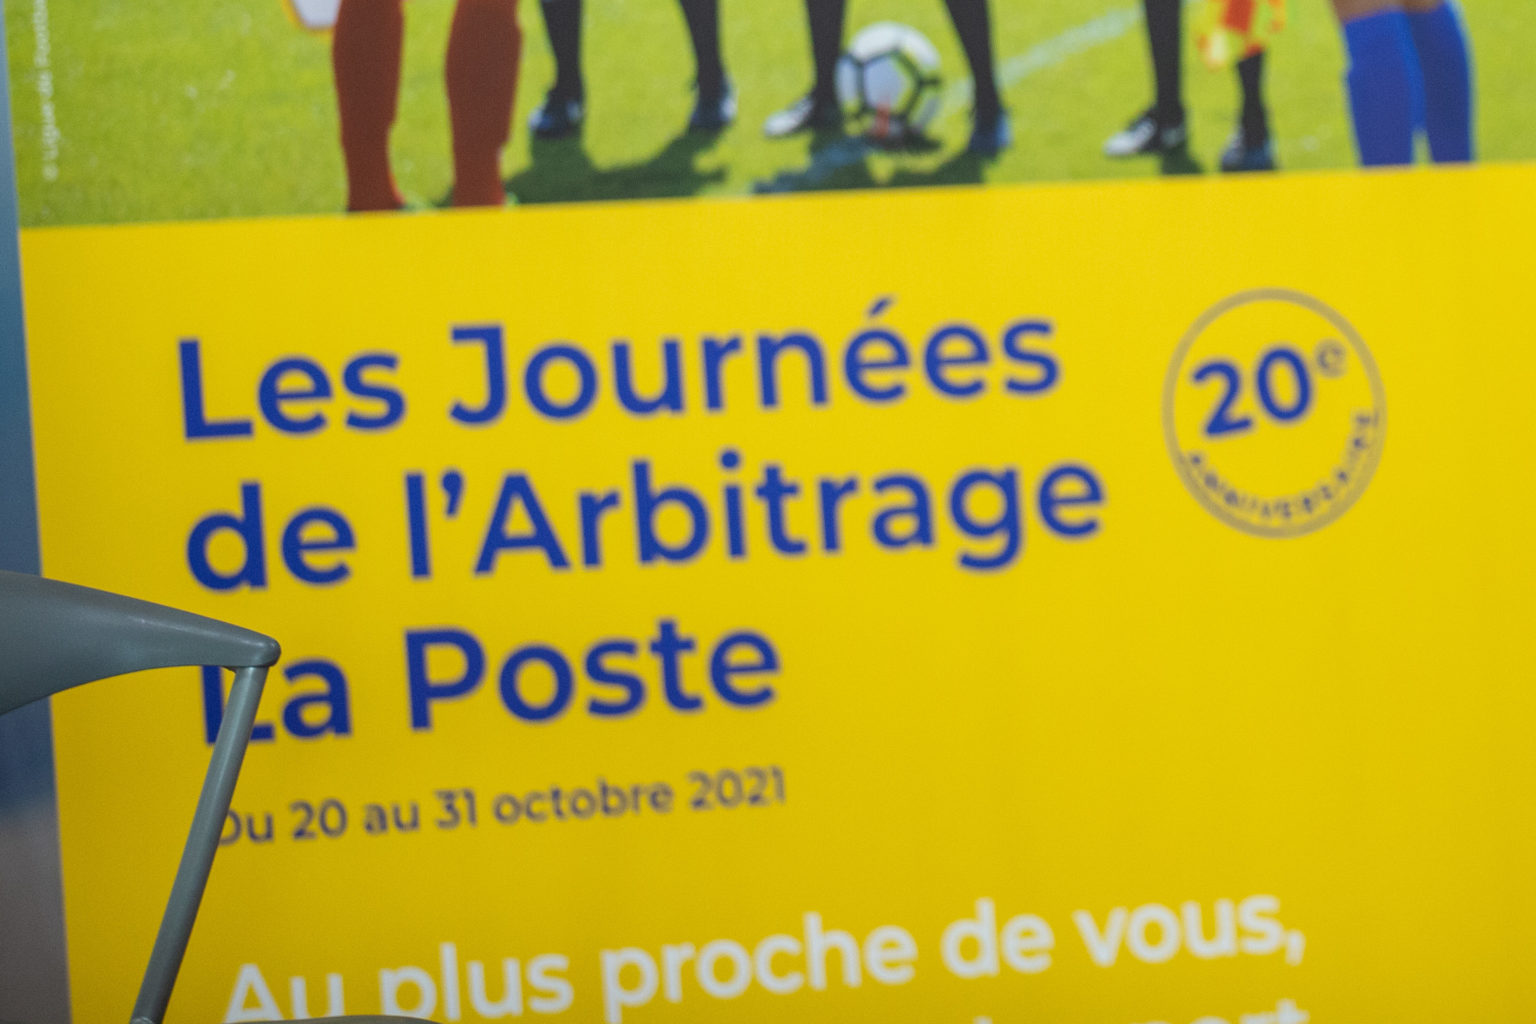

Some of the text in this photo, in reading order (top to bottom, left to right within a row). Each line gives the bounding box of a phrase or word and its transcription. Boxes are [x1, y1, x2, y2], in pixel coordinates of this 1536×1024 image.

[176, 294, 1064, 444] Les Journées
[184, 479, 358, 595] de
[402, 617, 782, 734] Poste
[288, 796, 350, 843] 20
[363, 800, 421, 837] au
[434, 786, 478, 831] 31
[491, 775, 676, 827] octobre
[686, 763, 788, 813] 2021
[222, 892, 1307, 1024] Au plus proche de vous,
